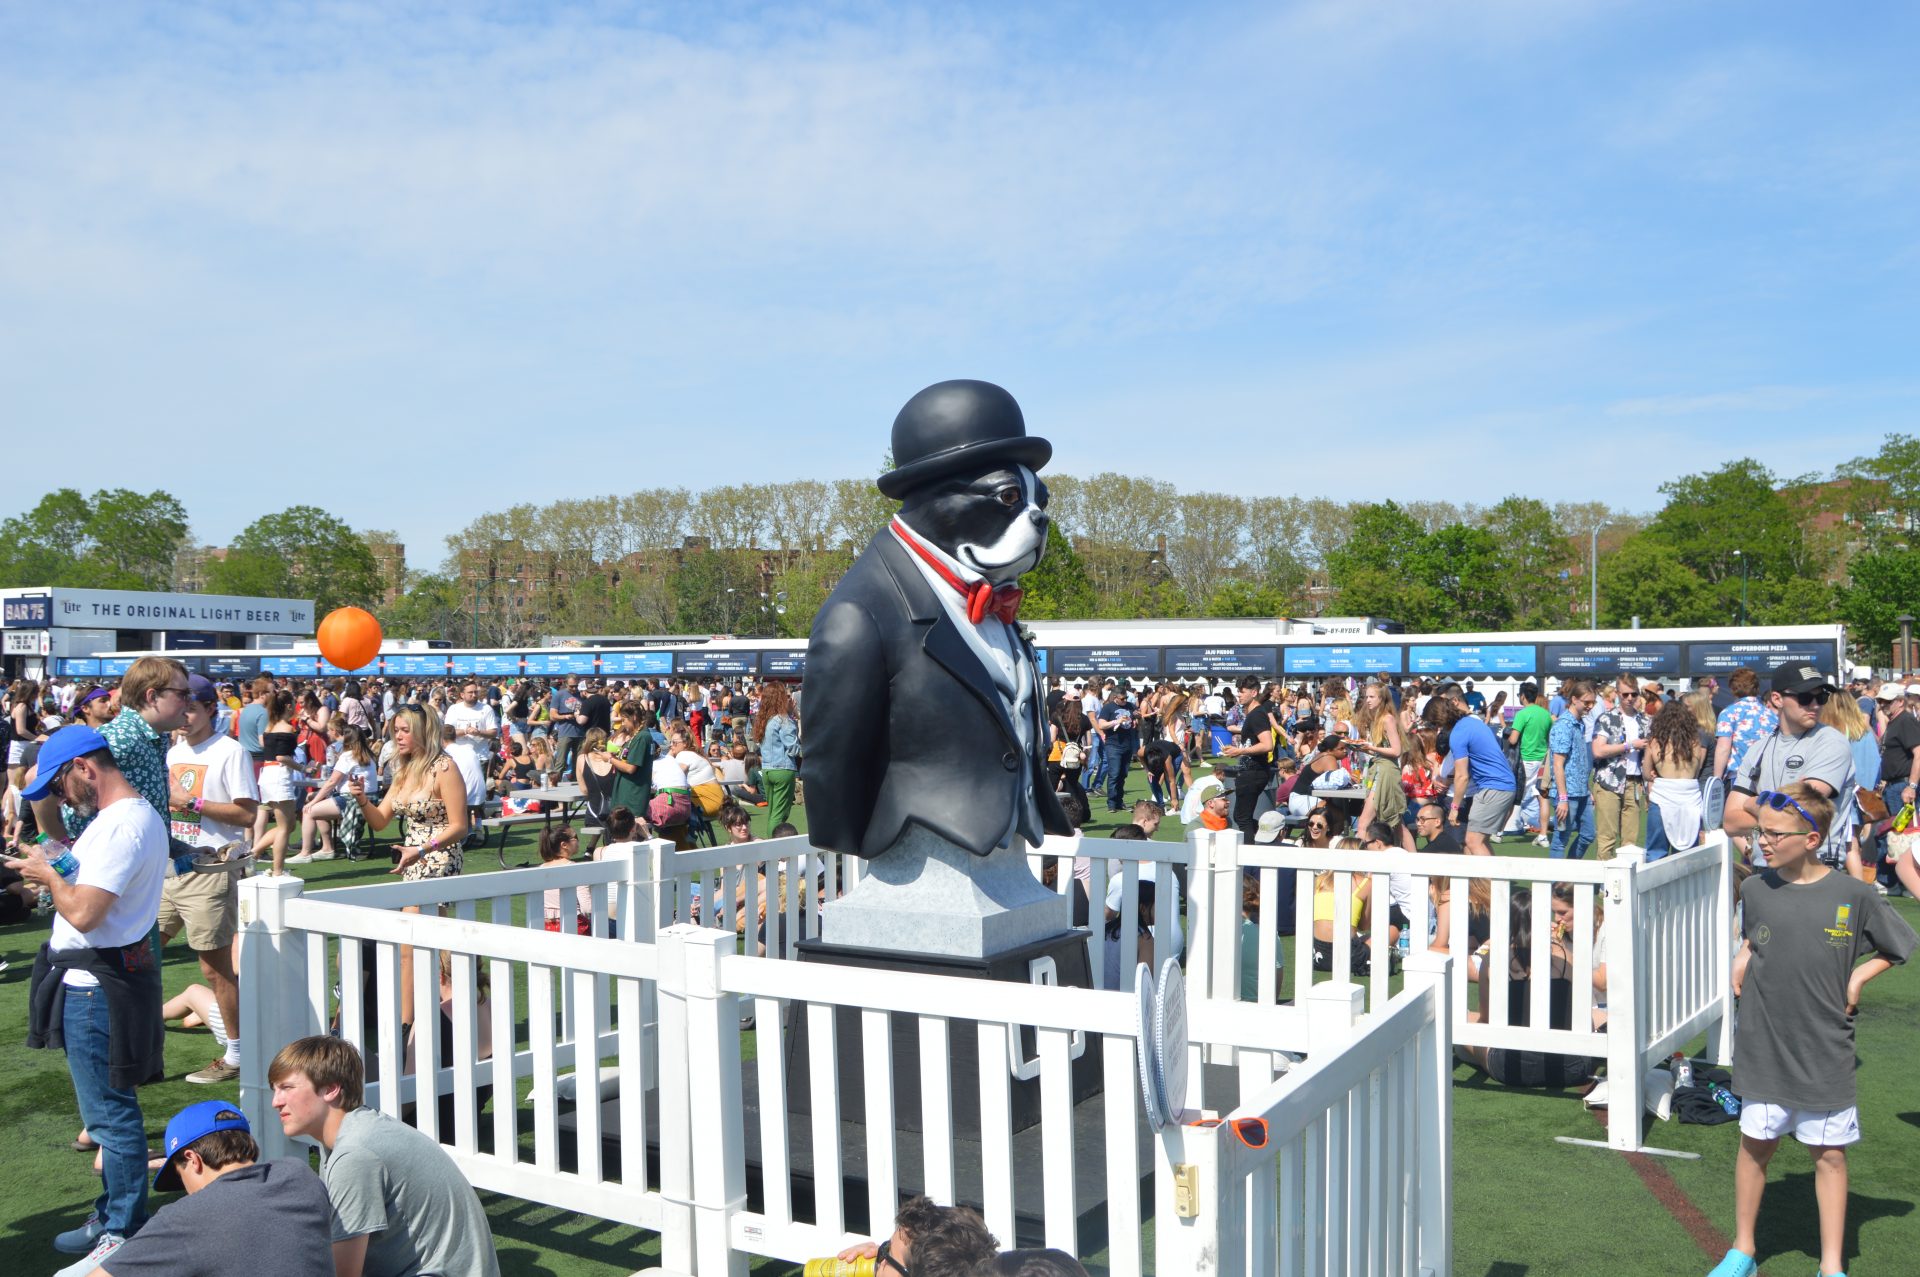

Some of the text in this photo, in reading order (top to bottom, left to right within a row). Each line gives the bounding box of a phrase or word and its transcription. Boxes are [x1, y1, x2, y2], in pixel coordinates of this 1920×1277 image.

[5, 603, 45, 620] BAR 75
[64, 602, 81, 614] Lite
[92, 604, 280, 622] THE ORIGINAL LIGHT BEER
[291, 610, 306, 622] Lite
